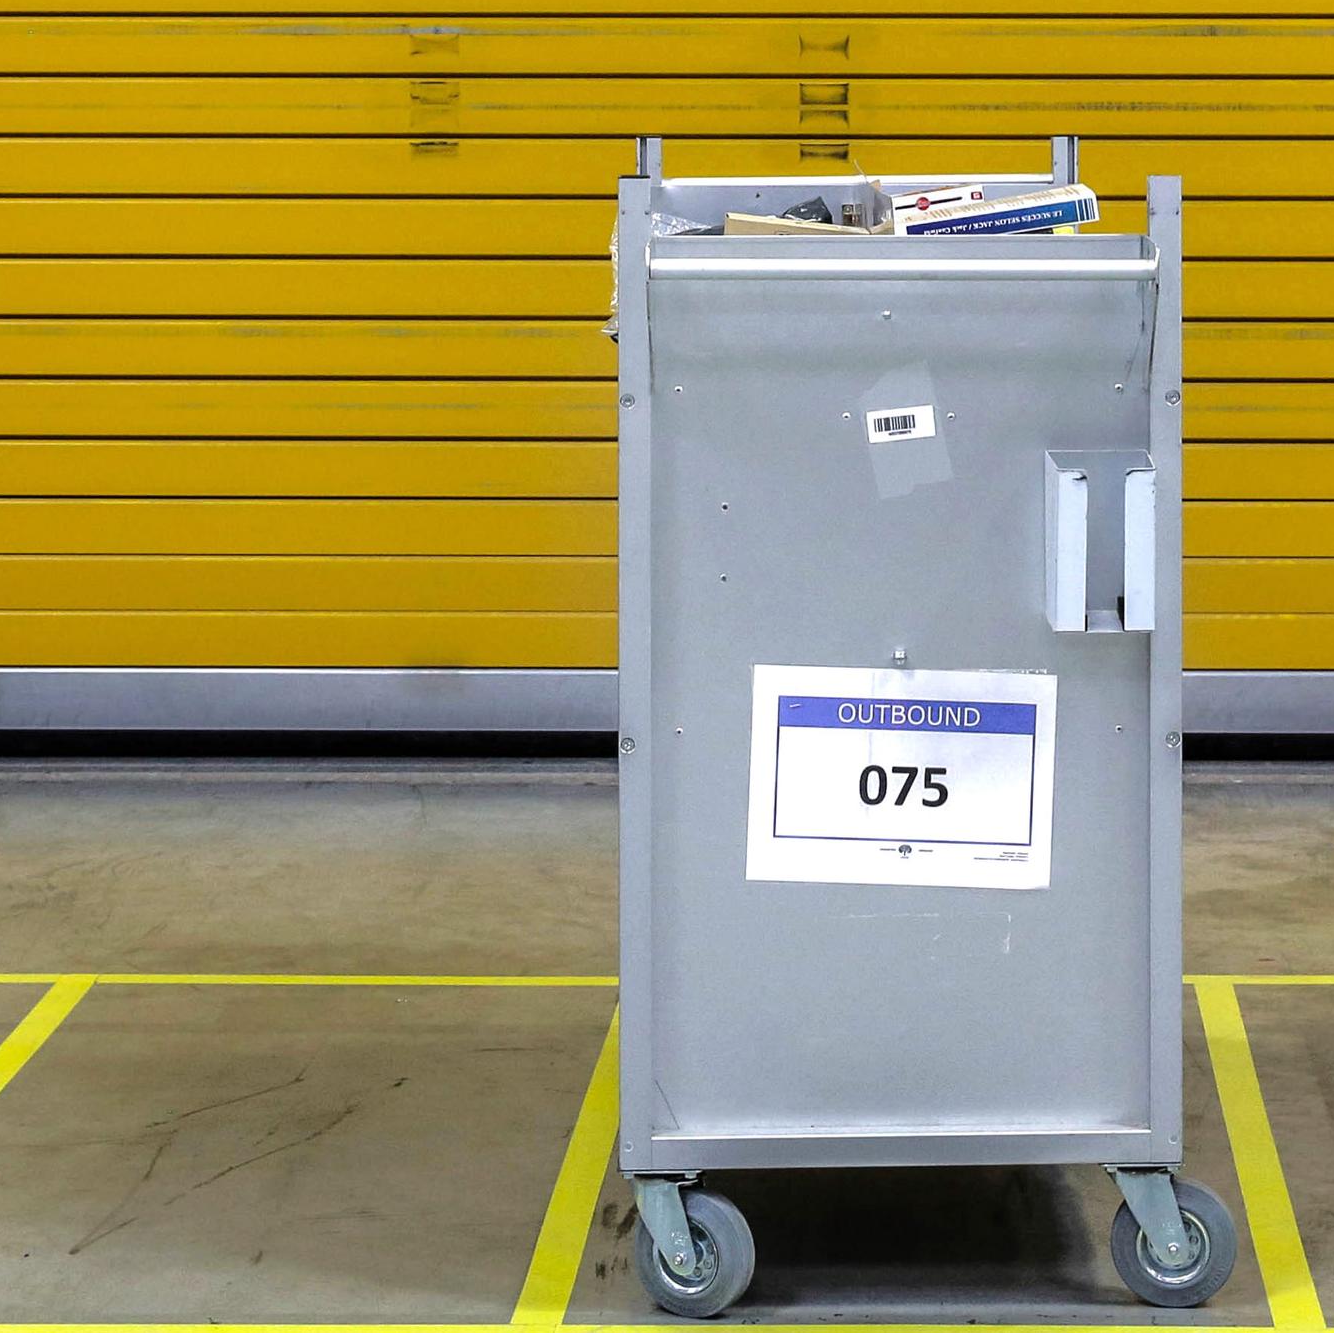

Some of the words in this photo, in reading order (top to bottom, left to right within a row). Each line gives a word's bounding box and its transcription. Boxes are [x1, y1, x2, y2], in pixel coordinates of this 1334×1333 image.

[1051, 209, 1063, 217] LE
[972, 220, 995, 229] JACK
[994, 216, 1021, 227] SELON
[837, 702, 982, 727] OUTBOUND
[858, 764, 949, 808] 075
